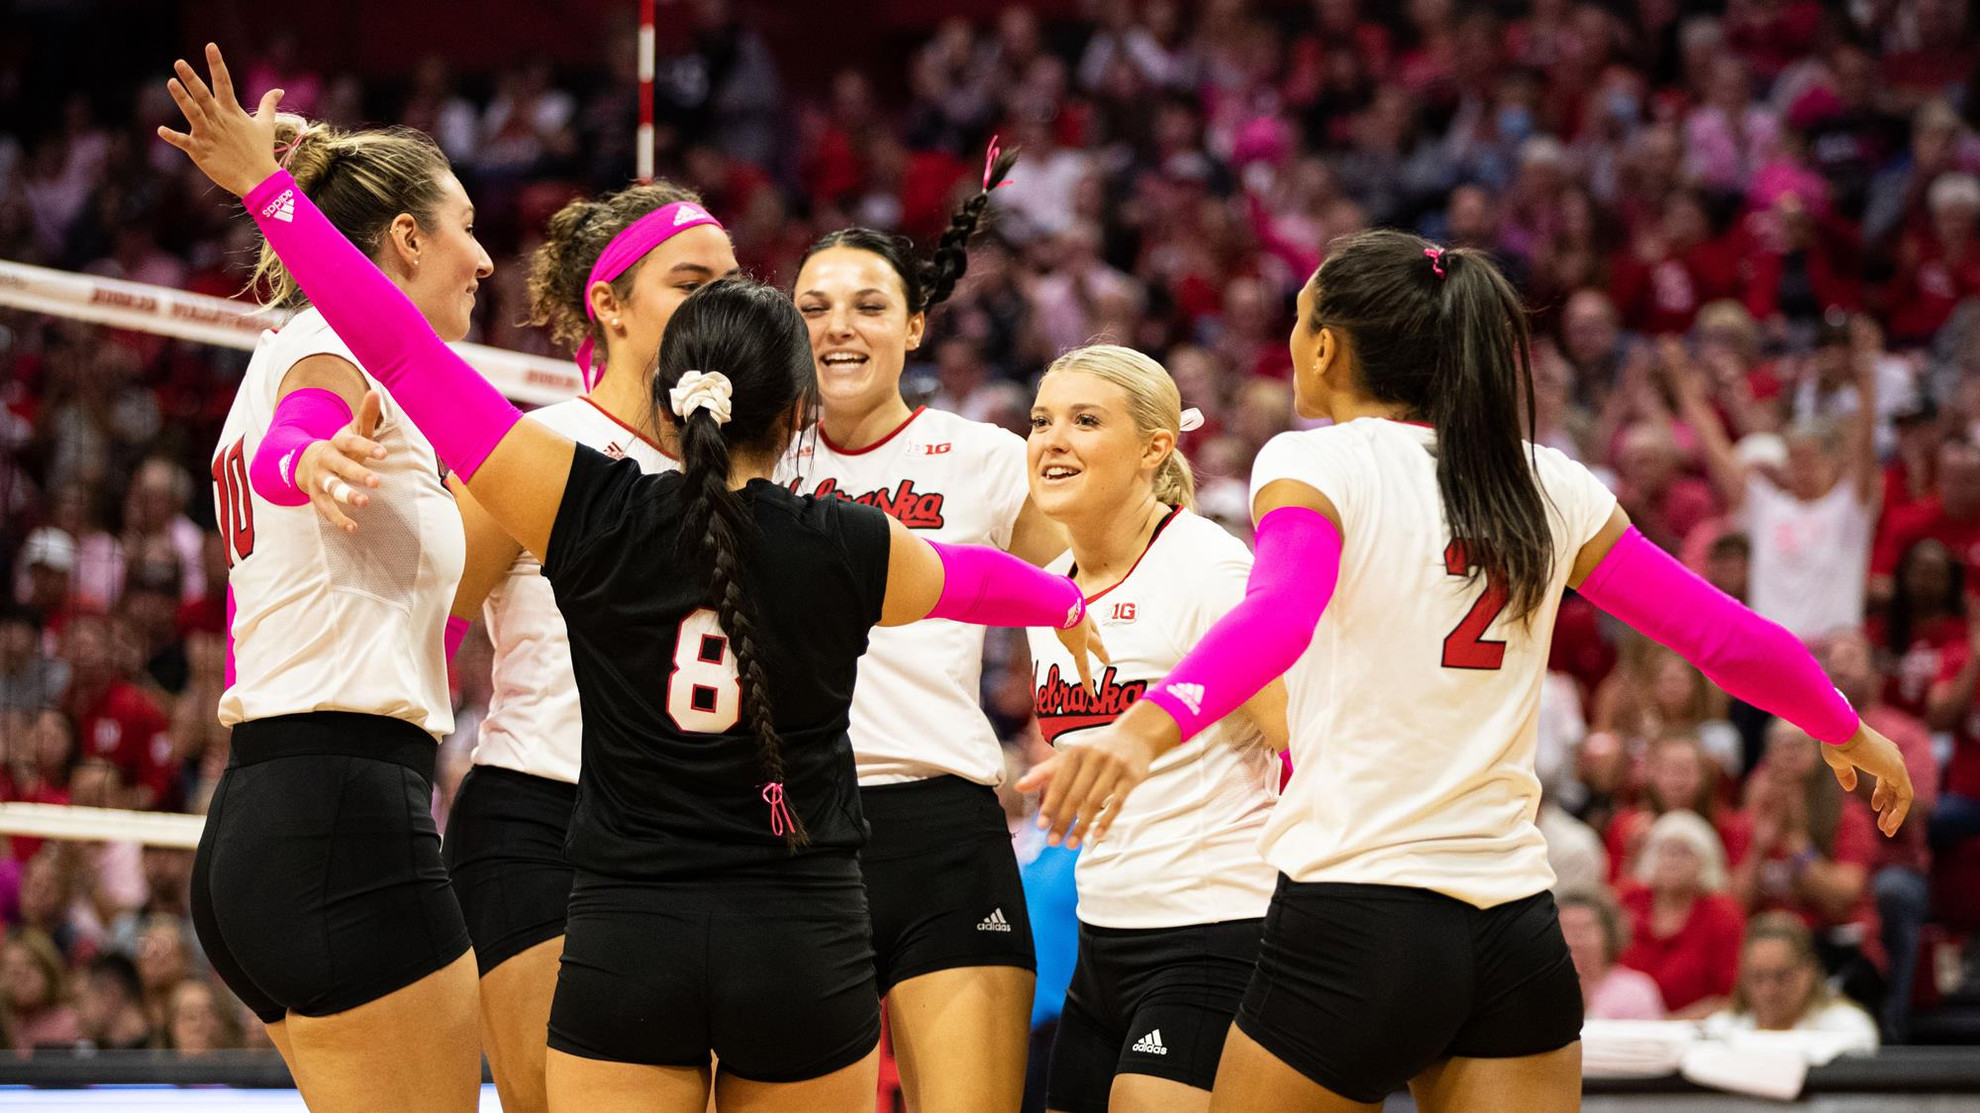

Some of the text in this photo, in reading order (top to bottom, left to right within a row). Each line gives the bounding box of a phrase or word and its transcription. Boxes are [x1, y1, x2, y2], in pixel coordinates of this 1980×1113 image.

[262, 190, 293, 217] adidas
[211, 432, 255, 569] 10
[1441, 537, 1507, 670] 2
[666, 606, 743, 734] 8
[1030, 660, 1147, 718] ebraska
[976, 923, 1011, 932] adidas
[1132, 1042, 1167, 1055] adidas
